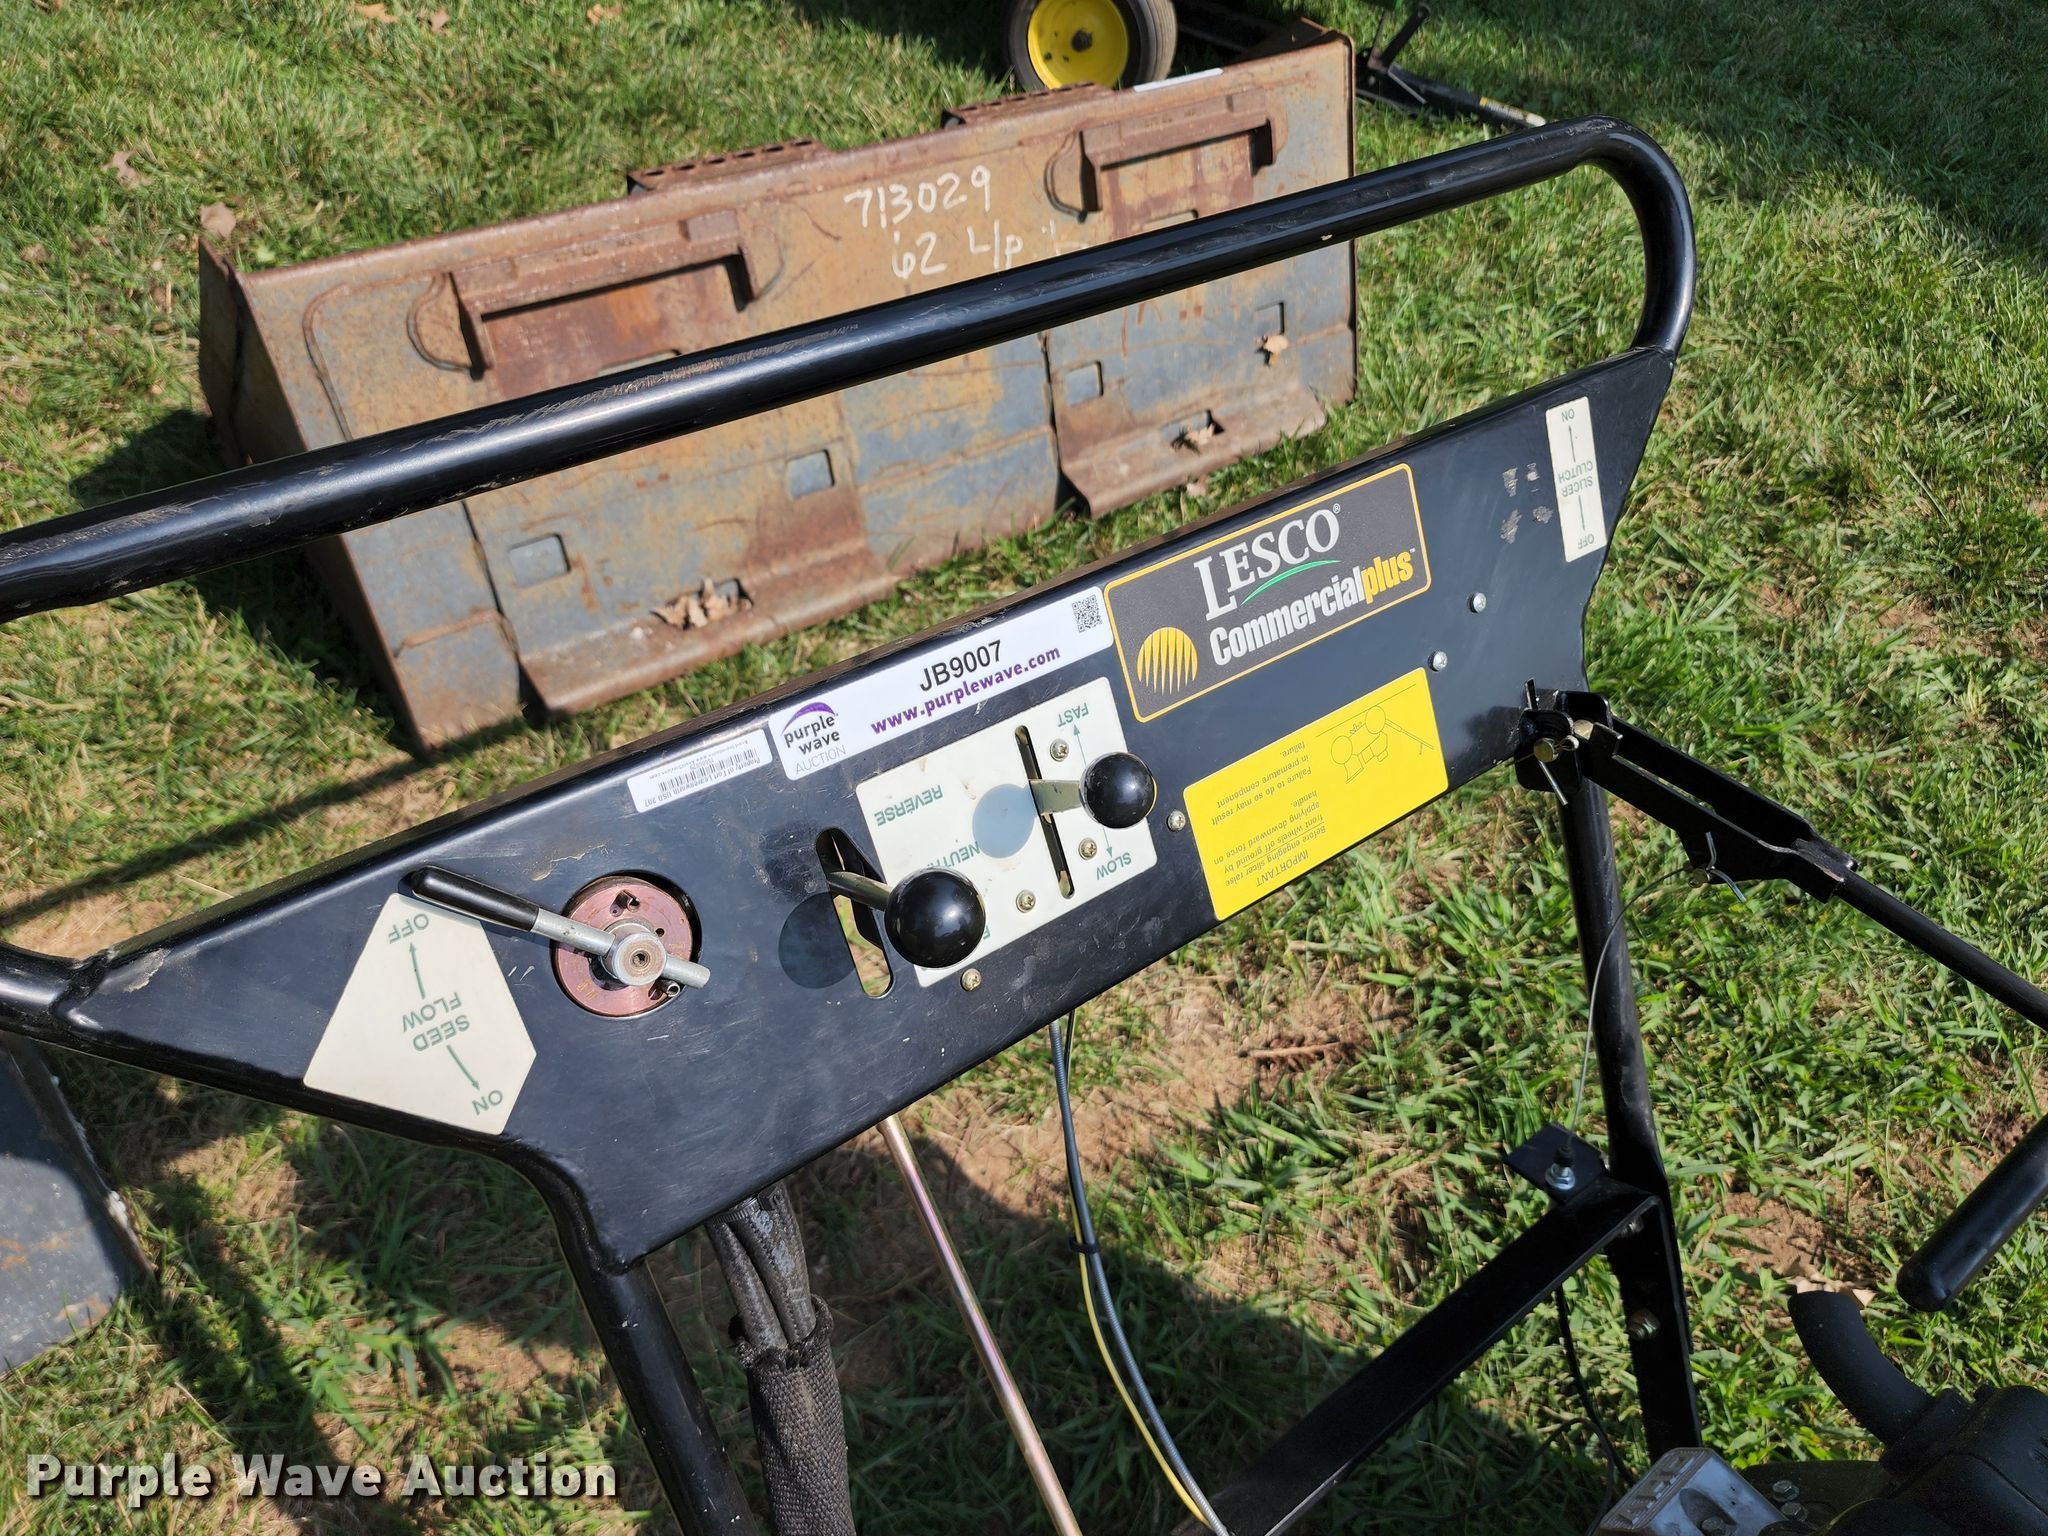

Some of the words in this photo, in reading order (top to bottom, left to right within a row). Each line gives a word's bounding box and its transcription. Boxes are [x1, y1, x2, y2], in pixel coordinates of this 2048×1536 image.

[843, 165, 991, 228] 713029
[891, 230, 948, 280] 62
[1561, 408, 1575, 422] ON
[1557, 460, 1594, 484] CLUTCH
[1561, 475, 1593, 498] SLICER
[1577, 533, 1595, 550] OFF
[918, 639, 1002, 692] JB9007
[870, 645, 1061, 734] www.purplewave.com
[1057, 701, 1090, 728] FAST
[783, 715, 835, 749] purple
[798, 730, 840, 755] wave
[795, 744, 847, 775] AUCTION
[1280, 741, 1305, 756] failure.
[1262, 758, 1299, 783] premature
[1287, 766, 1311, 783] Failure
[1216, 780, 1259, 808] component
[1265, 786, 1275, 795] do
[1277, 780, 1285, 788] to
[873, 783, 944, 827] REVERSE
[1236, 799, 1252, 811] may
[1254, 792, 1263, 801] so
[1290, 790, 1317, 807] handle.
[1211, 808, 1233, 825] result
[1289, 801, 1319, 822] applying
[1304, 814, 1323, 828] front
[1247, 820, 1287, 848] downward
[1277, 825, 1302, 843] wheels
[1302, 825, 1326, 842] Before
[1226, 843, 1246, 858] force
[1235, 846, 1262, 868] ground
[1264, 840, 1275, 853] off
[1266, 840, 1300, 863] engaging
[1095, 851, 1132, 881] SLOW
[1213, 855, 1223, 864] on
[1224, 864, 1234, 873] by
[1246, 859, 1265, 875] slicer
[1256, 849, 1308, 886] IMPORTANT
[1226, 872, 1243, 886] raise
[387, 912, 430, 944] OFF
[401, 991, 463, 1033] FLOW
[412, 1014, 471, 1052] SEED
[471, 1089, 504, 1116] ON
